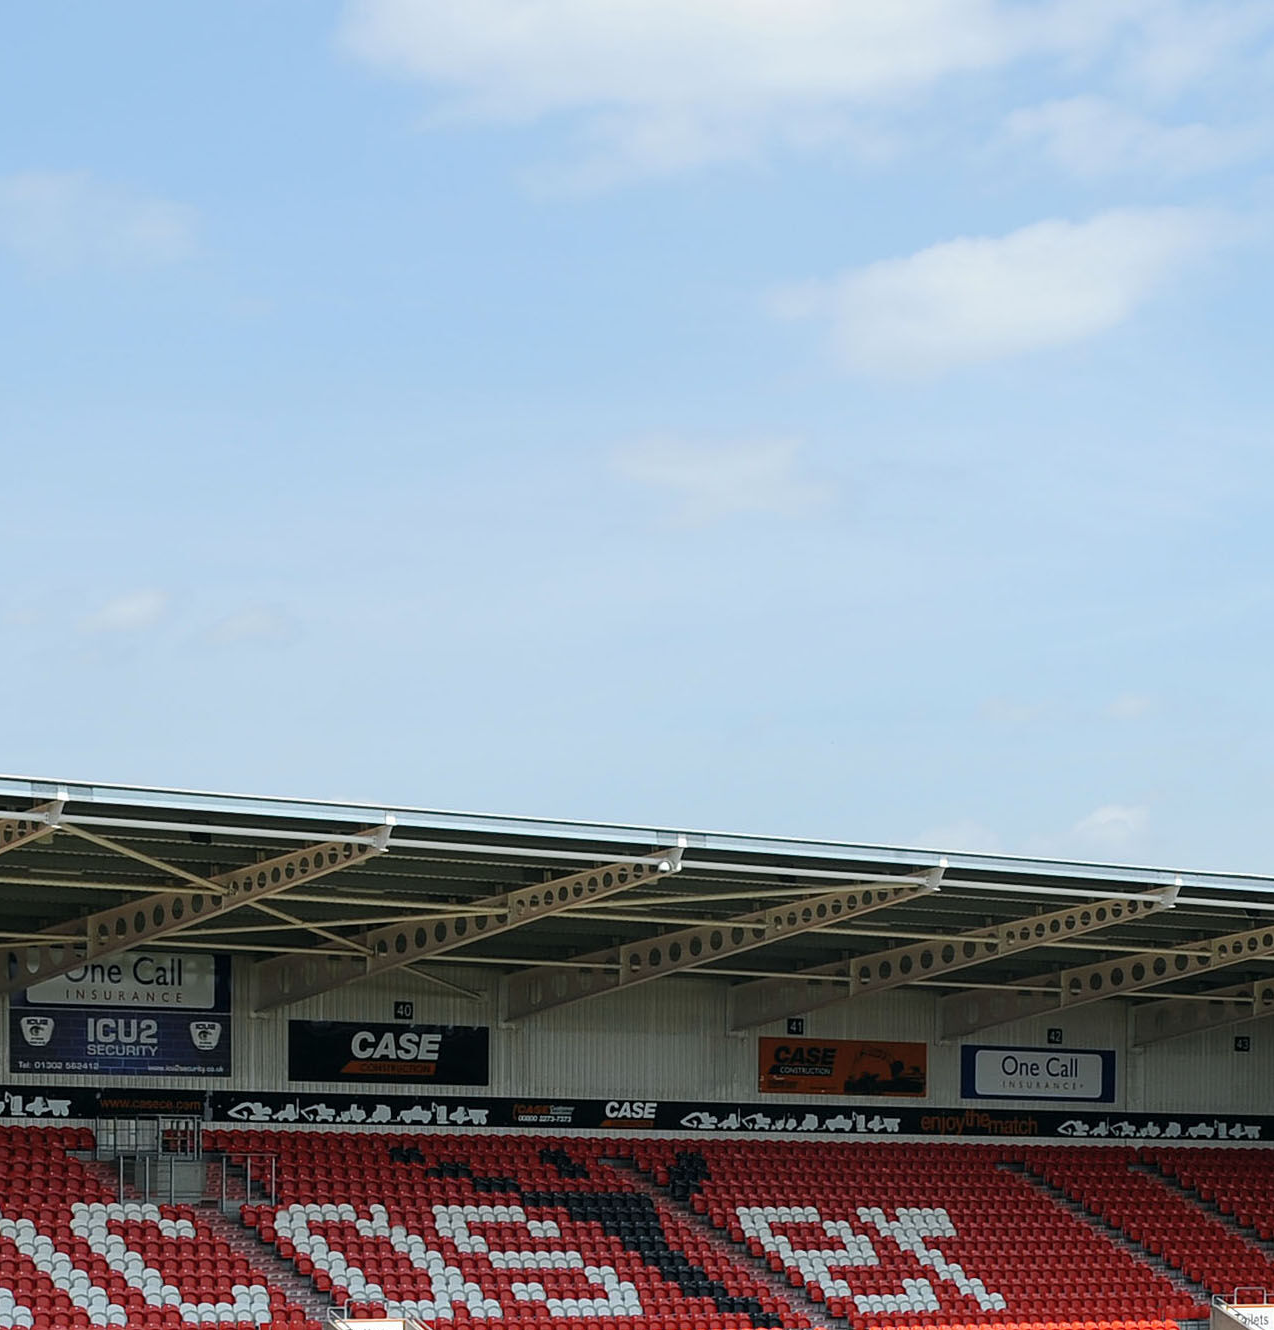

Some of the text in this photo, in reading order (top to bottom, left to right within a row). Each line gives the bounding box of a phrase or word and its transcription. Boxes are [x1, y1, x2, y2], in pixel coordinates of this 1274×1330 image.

[133, 956, 183, 987] Call
[66, 989, 182, 1003] INSURANCE
[397, 1004, 412, 1018] 40
[87, 1017, 159, 1044] ICU2
[790, 1021, 802, 1031] 41
[1049, 1031, 1061, 1042] 42
[1237, 1039, 1250, 1049] 43
[86, 1044, 159, 1057] SECURITY
[350, 1031, 442, 1060] CASE
[773, 1045, 838, 1065] CASE
[780, 1066, 832, 1075] CONSTRUCTION
[1001, 1055, 1079, 1079] One Call
[605, 1101, 657, 1119] CASE
[920, 1110, 1038, 1136] enjoy the match
